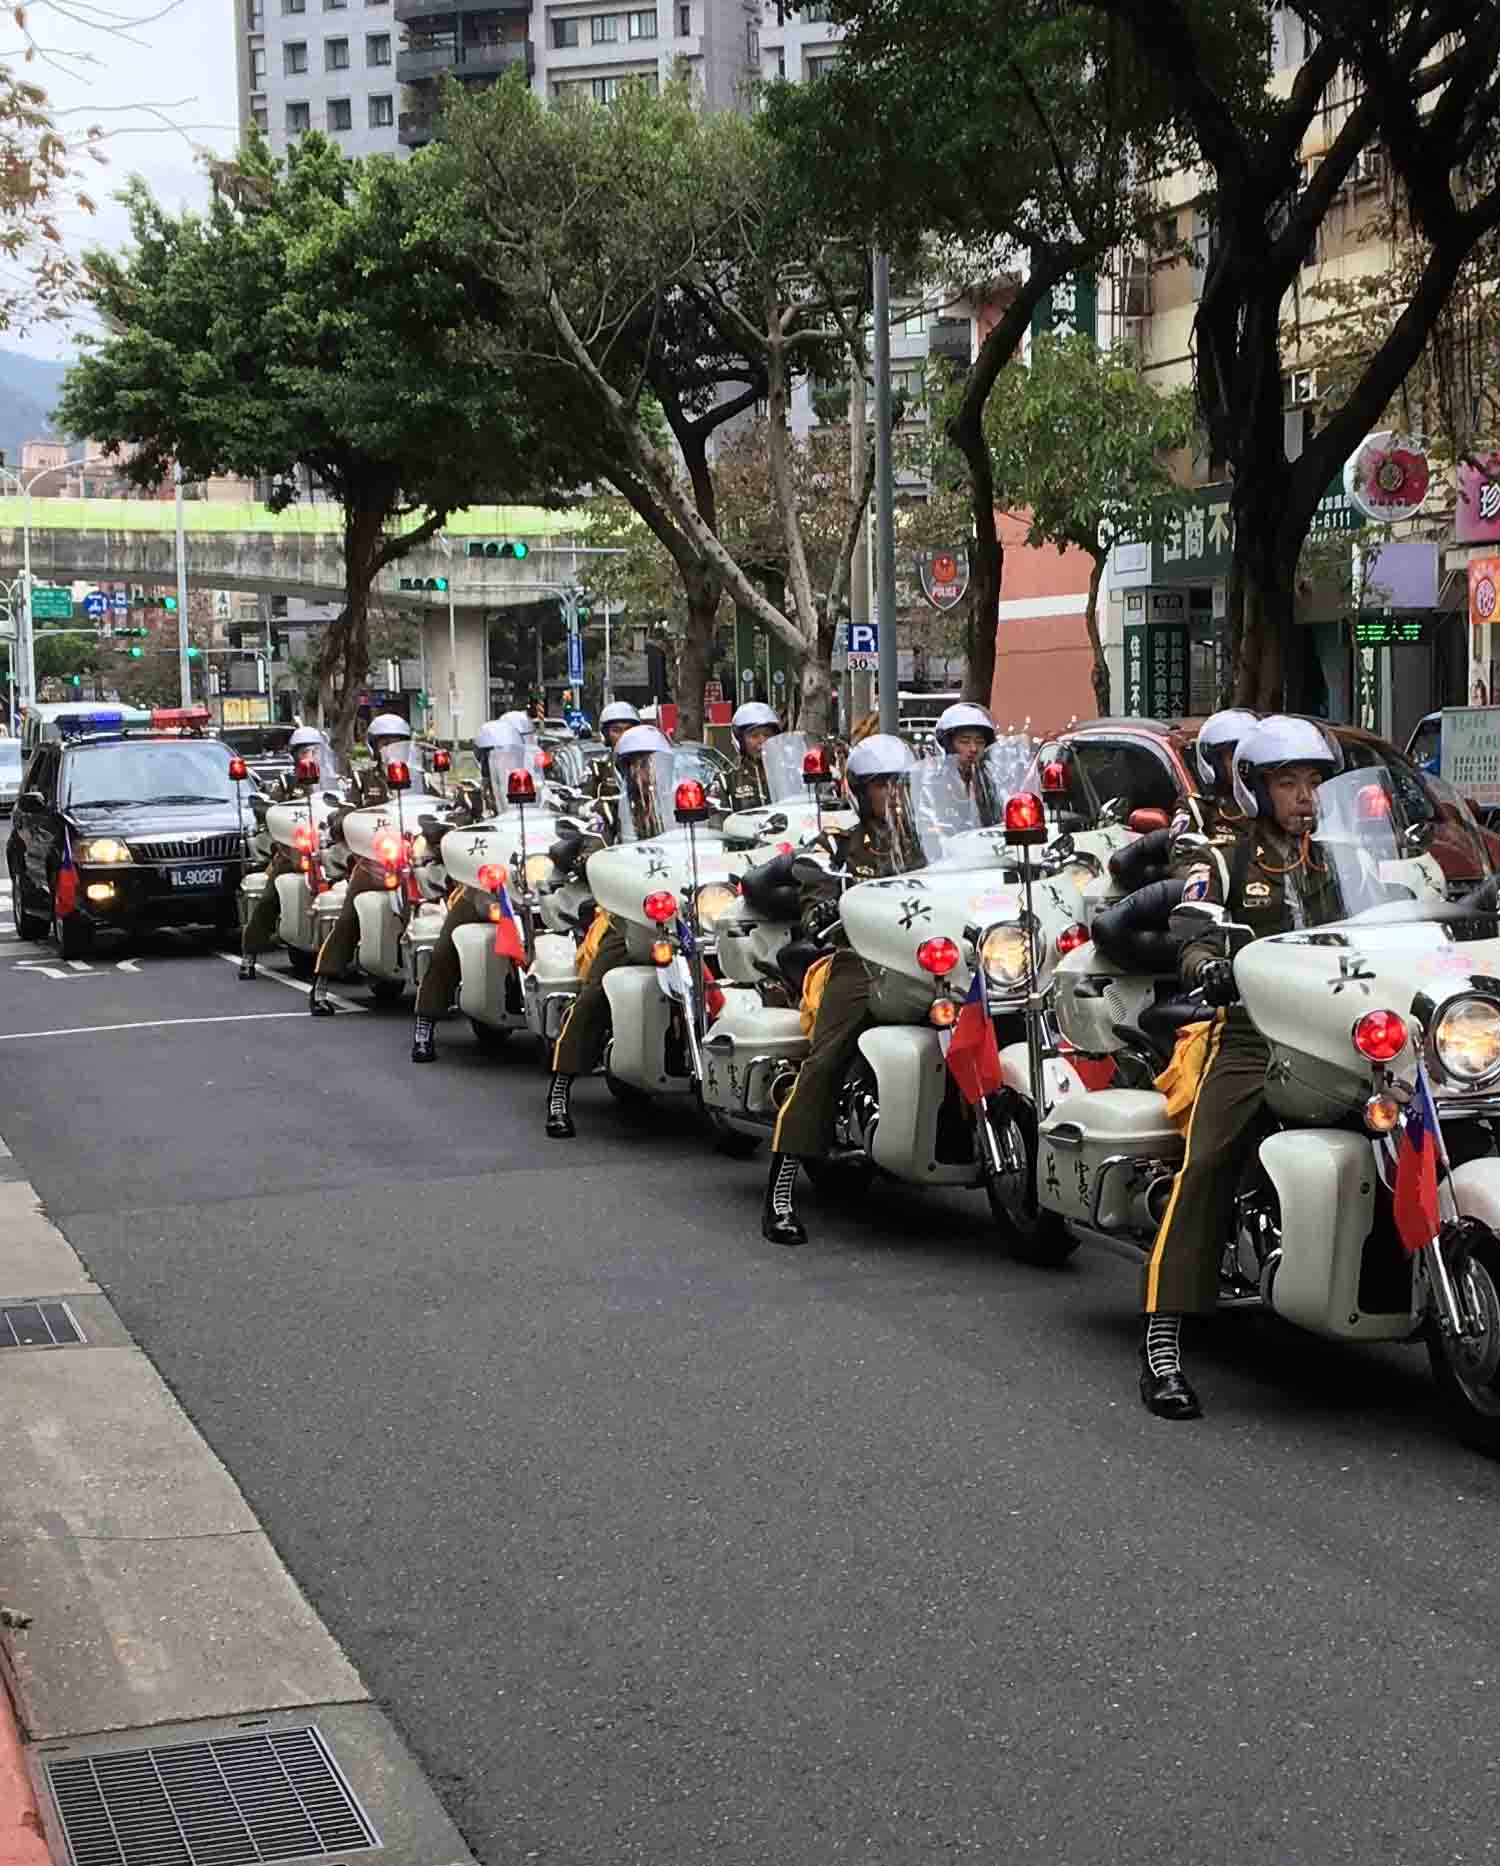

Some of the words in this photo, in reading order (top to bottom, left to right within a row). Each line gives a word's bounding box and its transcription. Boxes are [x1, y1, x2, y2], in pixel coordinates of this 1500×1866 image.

[1163, 501, 1237, 564] 住商不
[852, 626, 873, 651] P
